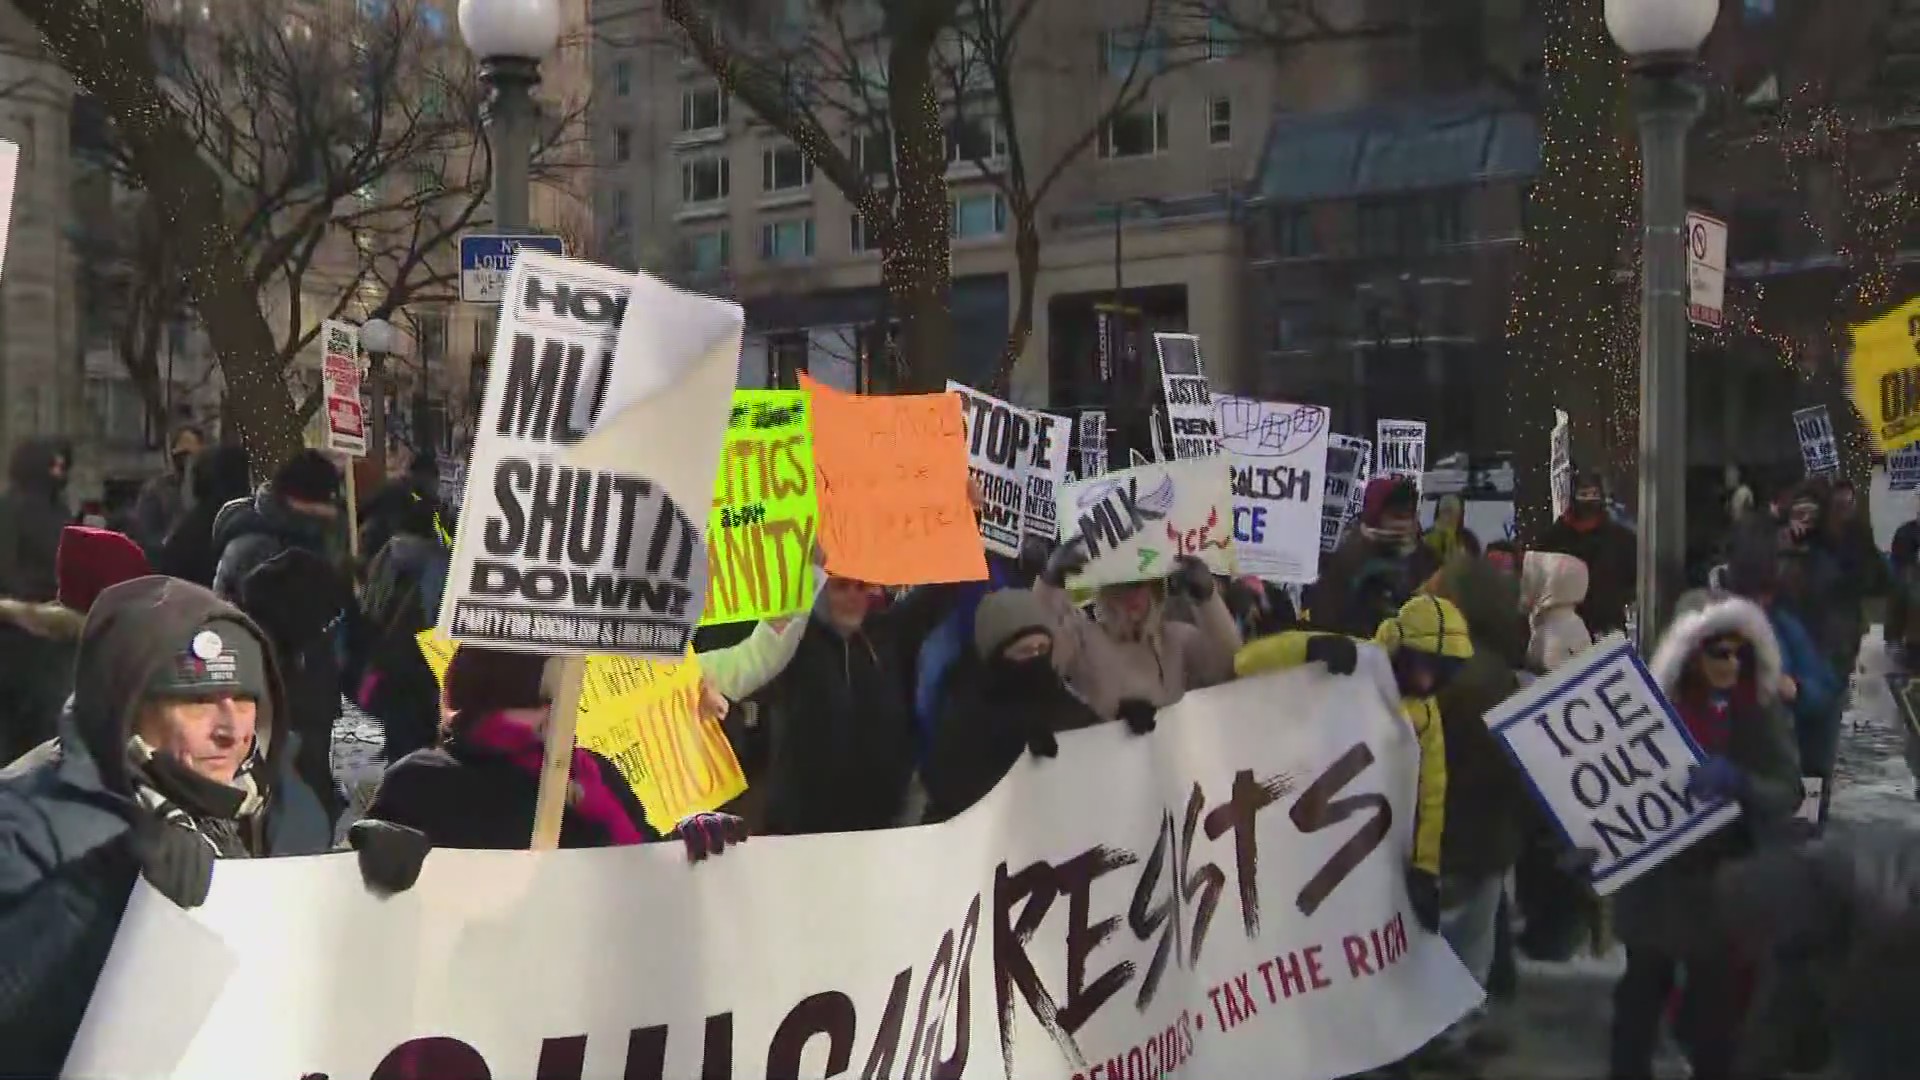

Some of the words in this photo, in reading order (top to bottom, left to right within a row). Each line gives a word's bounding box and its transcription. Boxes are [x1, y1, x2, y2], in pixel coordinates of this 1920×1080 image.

[483, 458, 653, 570] SHUT
[1079, 477, 1146, 560] MLK
[1534, 669, 1651, 757] ICE
[1571, 721, 1665, 809] OUT
[992, 741, 1393, 1080] RESISTS
[1207, 973, 1259, 1033] TAX
[1258, 944, 1333, 1005] THE
[1342, 911, 1409, 979] RICH
